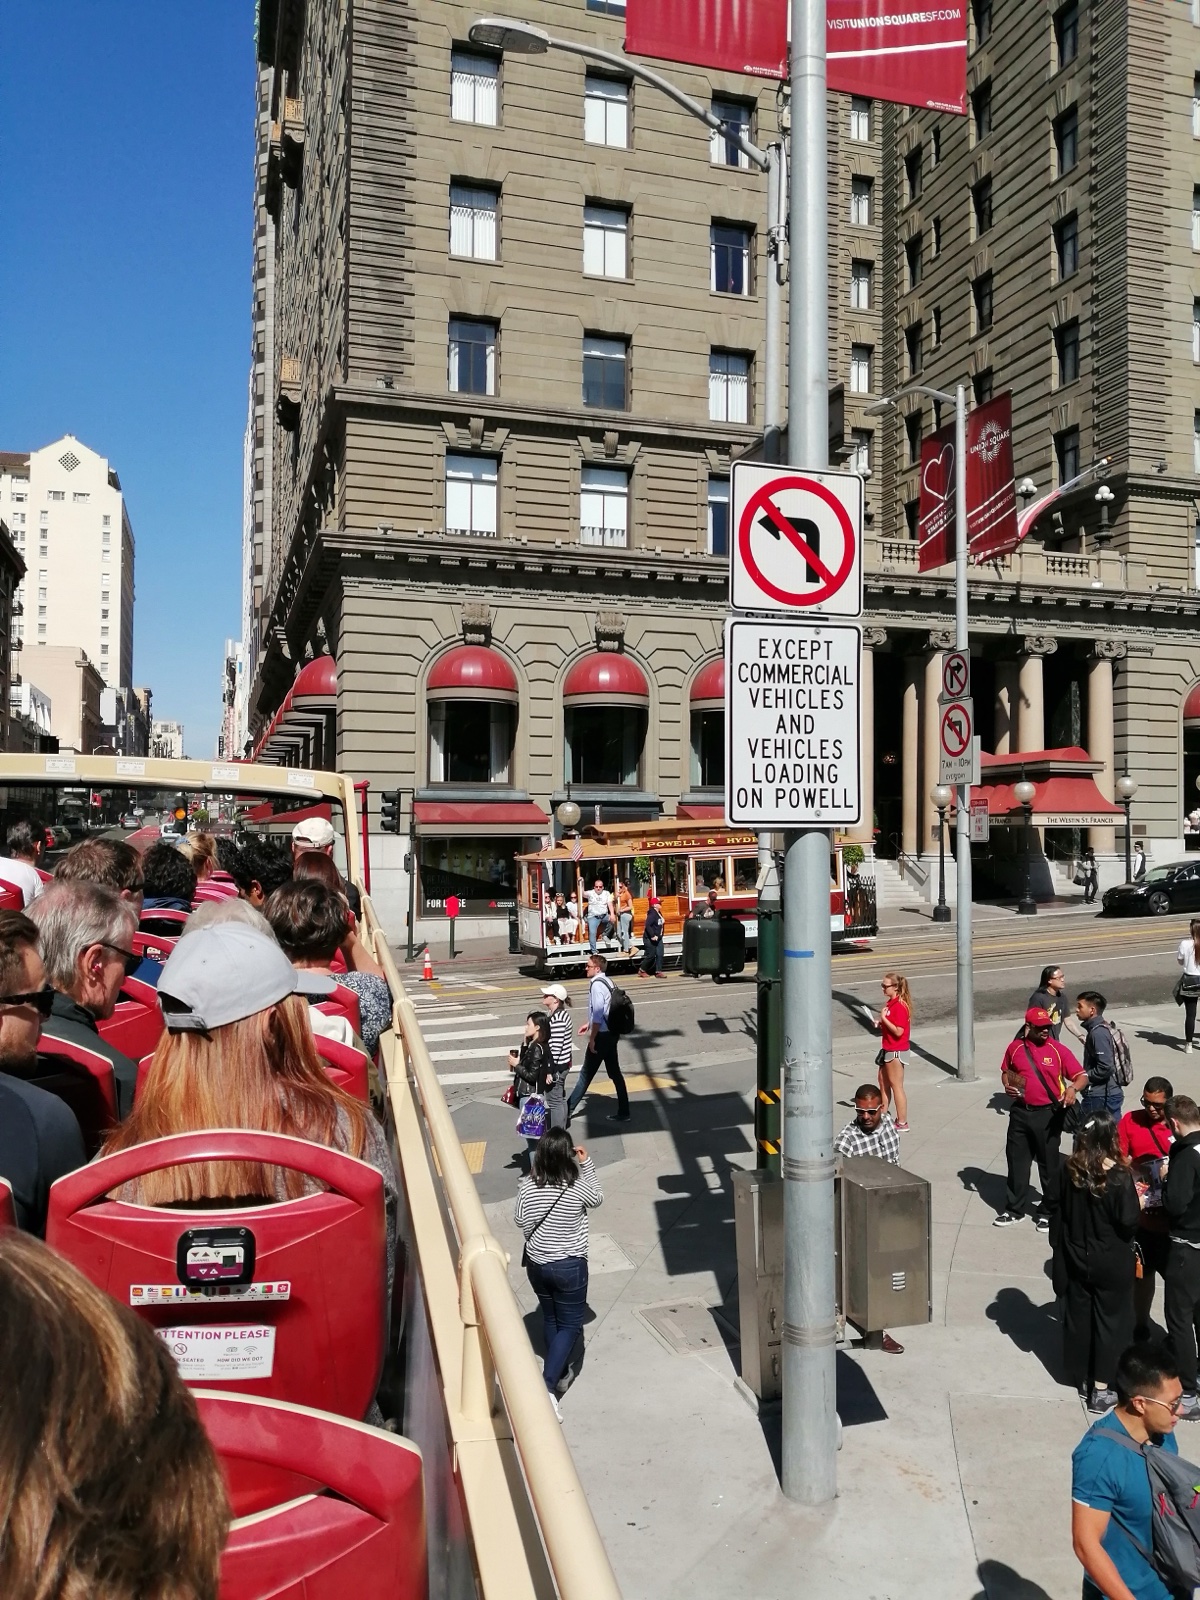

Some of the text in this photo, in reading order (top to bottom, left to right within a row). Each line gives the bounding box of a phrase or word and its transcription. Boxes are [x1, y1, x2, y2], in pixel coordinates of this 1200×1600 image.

[826, 8, 961, 29] VISITUNIONSQUARESF.COM
[970, 429, 1010, 454] UNION SQUARE
[759, 638, 833, 660] EXCEPT
[738, 662, 853, 685] COMMERCIAL
[749, 688, 844, 710] VEHICLES
[776, 714, 815, 734] AND
[748, 738, 843, 760] VEHICLES
[752, 763, 838, 784] LOADING
[737, 788, 853, 809] ON POWELL
[646, 840, 700, 848] POWELL
[426, 899, 466, 908] FOR LSE
[224, 1329, 270, 1340] PLEASE
